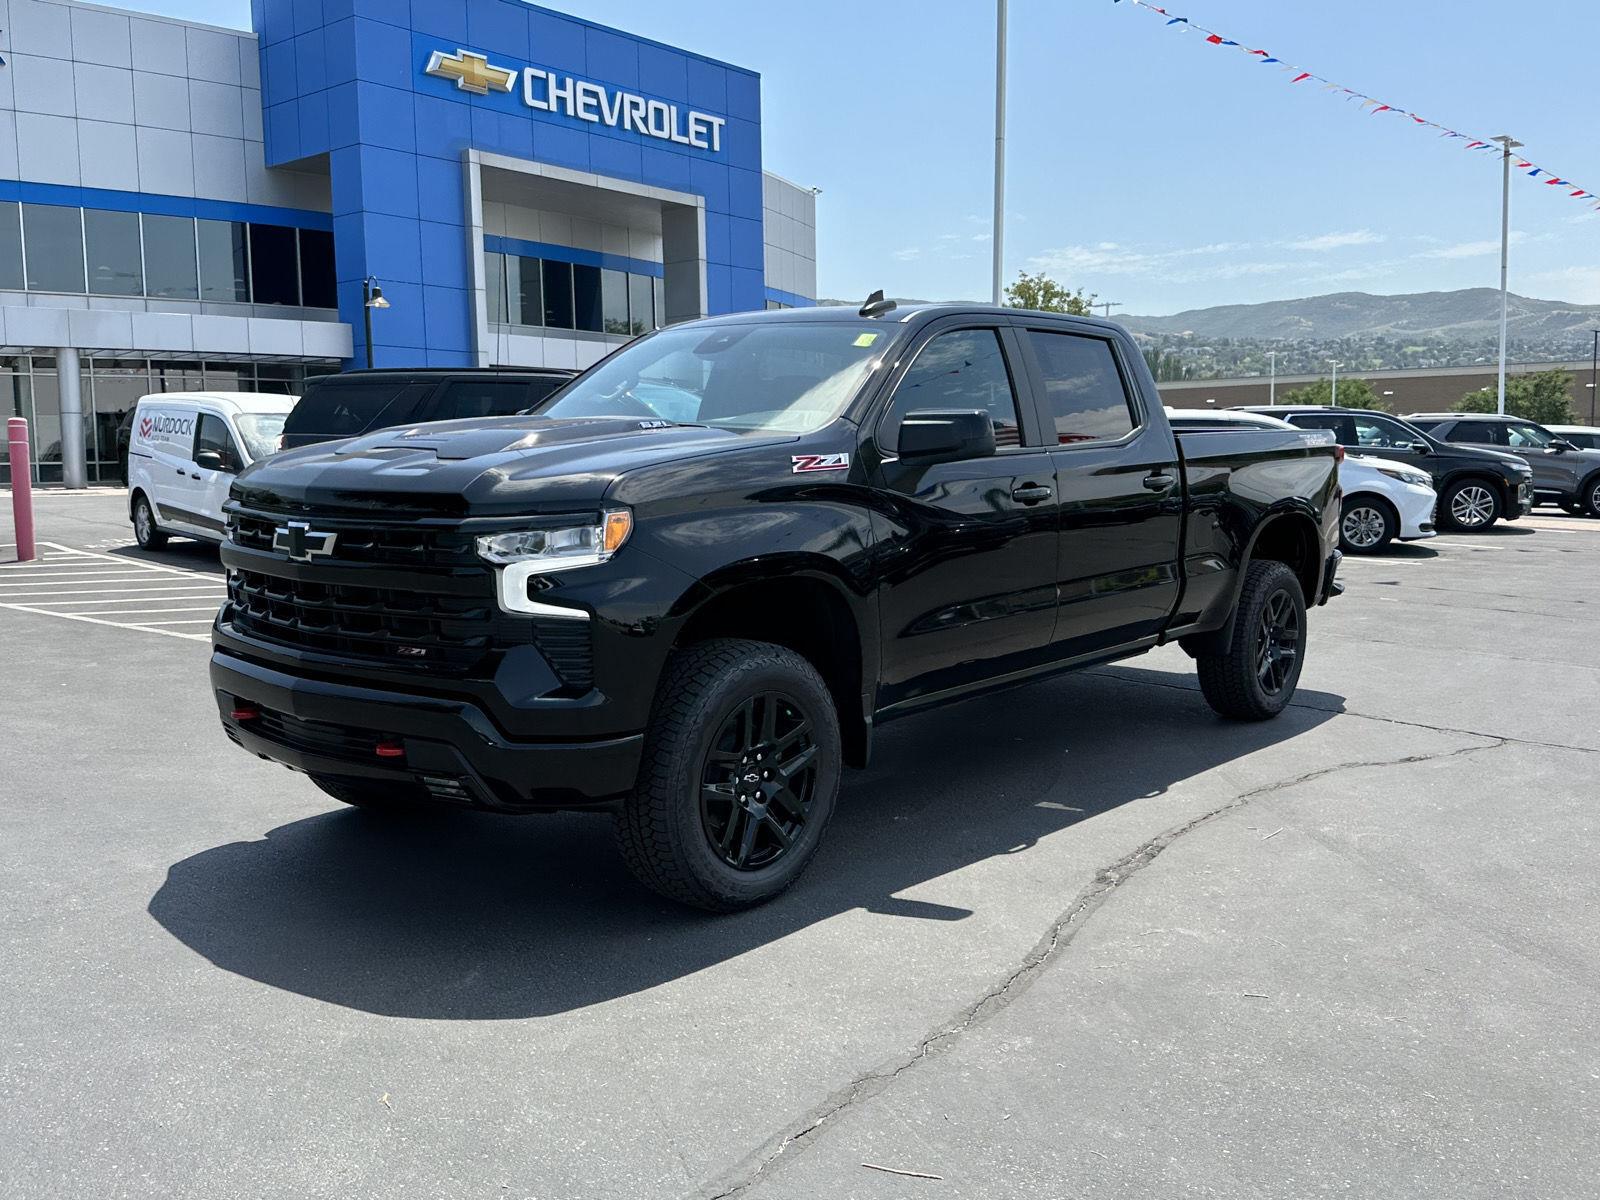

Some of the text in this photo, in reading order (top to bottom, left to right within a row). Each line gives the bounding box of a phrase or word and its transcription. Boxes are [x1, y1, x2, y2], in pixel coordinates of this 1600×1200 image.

[523, 66, 726, 152] CHEVROLET
[152, 416, 194, 435] MURDOCK
[791, 452, 850, 474] Z71
